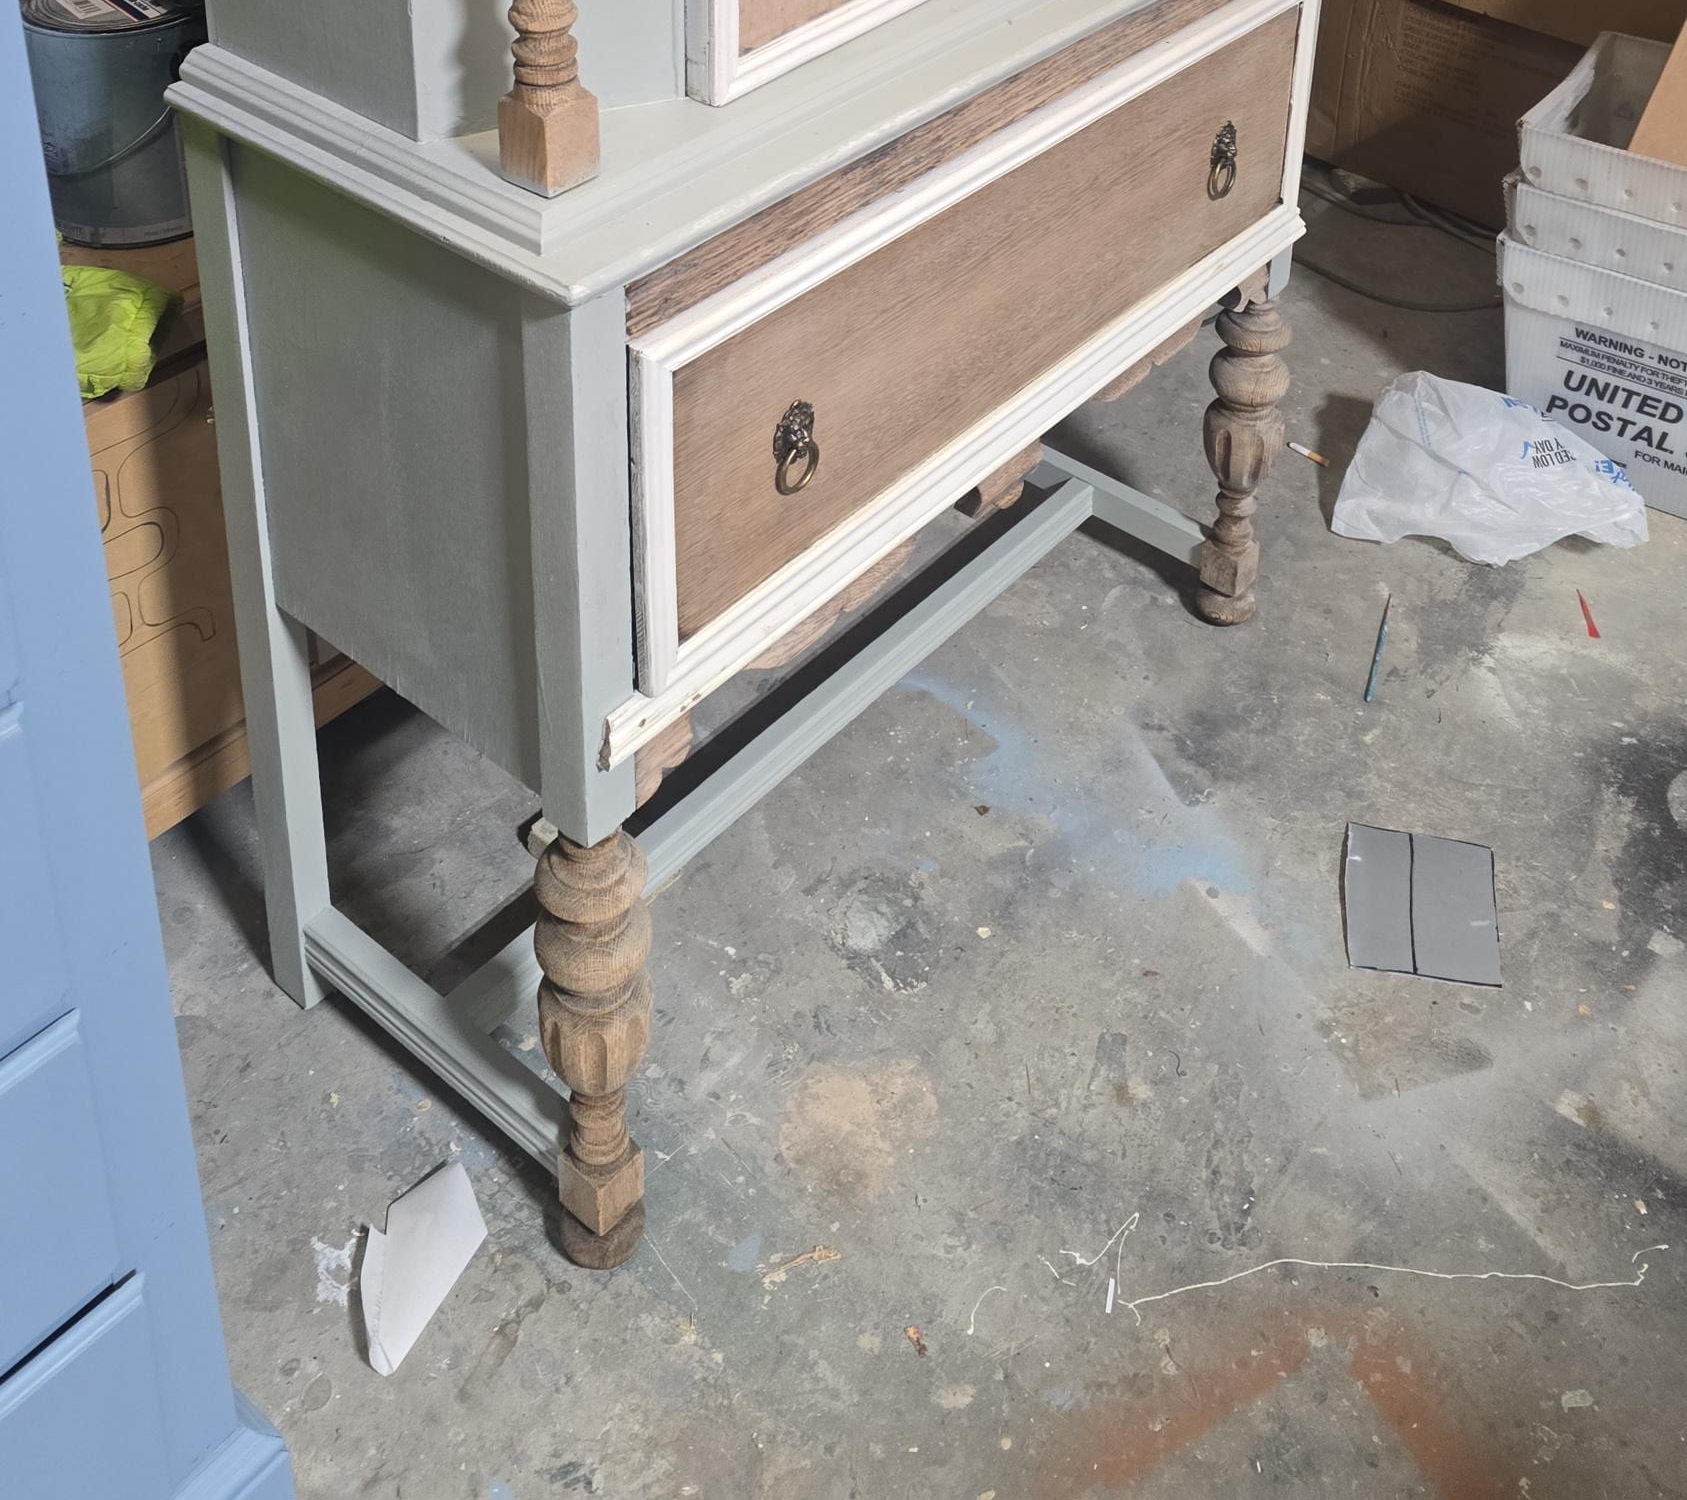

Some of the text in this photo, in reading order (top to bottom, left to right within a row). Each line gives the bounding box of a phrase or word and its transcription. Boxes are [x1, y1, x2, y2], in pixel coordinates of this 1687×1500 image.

[1559, 340, 1601, 359] MAXIMUM
[1601, 353, 1640, 371] PENALTY
[1640, 365, 1661, 379] FOR
[1575, 327, 1645, 359] WARNING
[1657, 353, 1687, 373] NOT
[1579, 355, 1606, 371] $1,000
[1606, 364, 1627, 378] FINE
[1626, 371, 1647, 383] AND
[1653, 379, 1684, 396] YEARS
[1563, 369, 1684, 424] UNITED
[1545, 394, 1674, 455] POSTAL
[1531, 453, 1555, 469] LOW
[1533, 439, 1554, 454] DAY
[1634, 450, 1687, 476] FOR MAI
